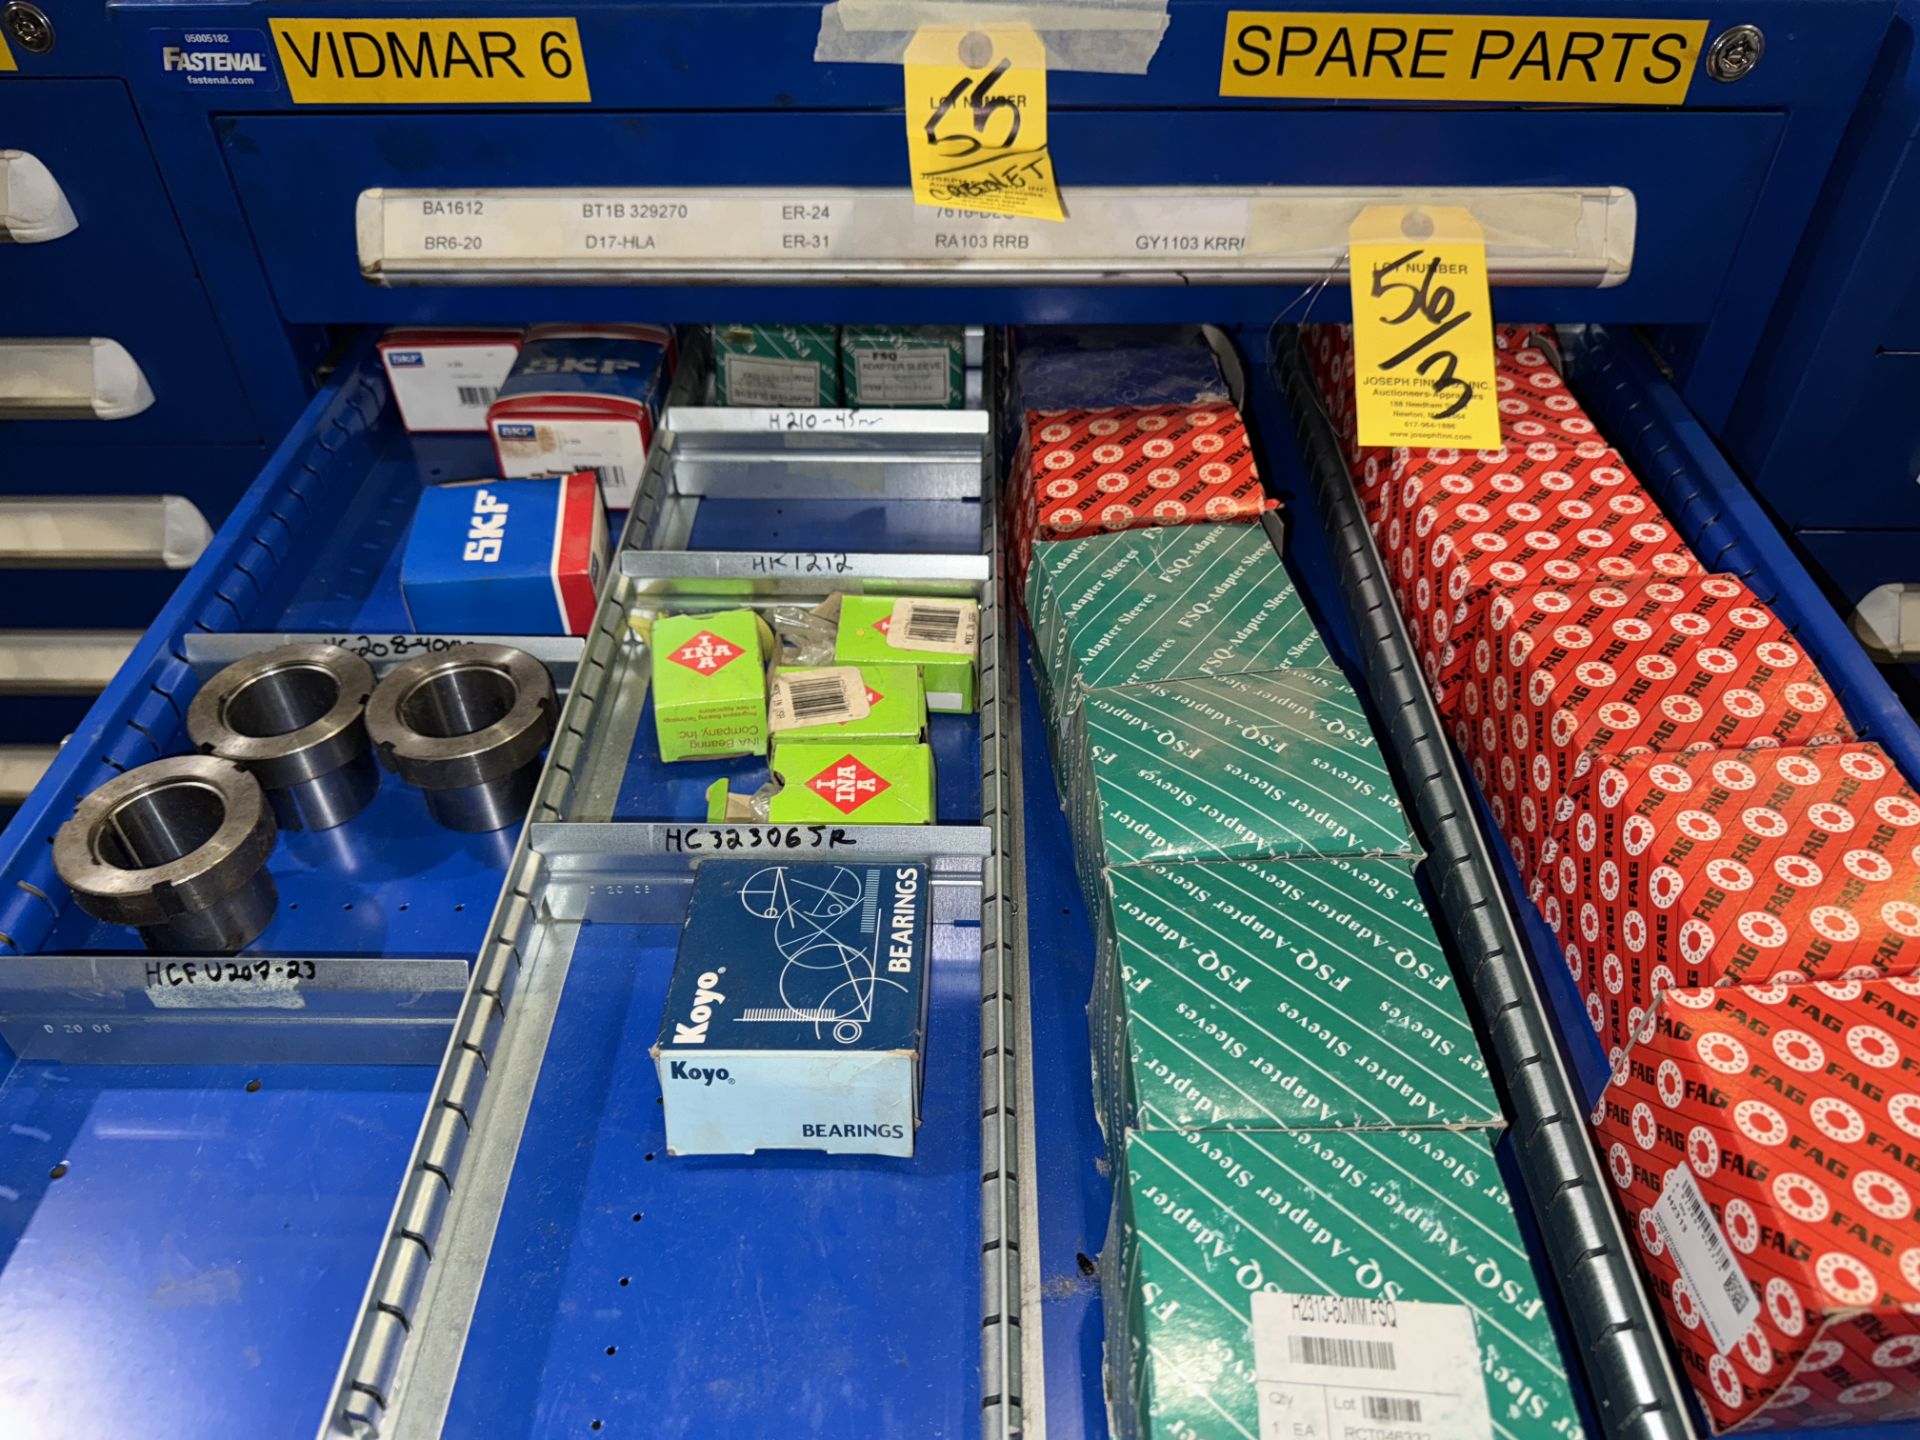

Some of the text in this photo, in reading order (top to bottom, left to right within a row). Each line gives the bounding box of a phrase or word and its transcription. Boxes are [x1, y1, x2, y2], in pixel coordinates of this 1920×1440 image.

[184, 34, 230, 44] 05005182
[162, 46, 267, 72] FASTENAL
[282, 30, 573, 80] VIDMAR 6
[1232, 24, 1688, 85] SPARE PARTS
[187, 74, 255, 85] fastenal.com
[423, 201, 484, 216] BA1612
[582, 204, 688, 219] BT1B 329270
[782, 206, 830, 220] ER-24
[424, 236, 483, 251] BR6-20
[585, 236, 656, 250] D17-HLA
[782, 235, 830, 249] ER-31
[935, 235, 1030, 250] RA103 RRB
[1136, 236, 1199, 251] GY1103
[522, 358, 640, 376] SKF
[862, 361, 942, 371] ADAPTER SLEEVE
[871, 351, 898, 361] FSQ
[1363, 377, 1410, 387] JOSEPH
[1405, 401, 1443, 409] Needham
[501, 426, 532, 437] SKF
[1511, 459, 1535, 478] FAG
[1476, 488, 1501, 509] FAG
[1527, 487, 1552, 506] FAG
[1578, 483, 1603, 502] FAG
[462, 489, 510, 563] SKF
[1494, 518, 1519, 537] FAG
[1545, 514, 1571, 534] FAG
[752, 554, 854, 573] HK1212
[1101, 548, 1140, 581] Sleeves
[1158, 524, 1226, 584] FSQ-Adapter
[1117, 591, 1158, 626] Sleeves
[1177, 564, 1247, 629] FSQ-Adapter
[1517, 610, 1547, 635] FAG
[1575, 606, 1606, 629] FAG
[1198, 609, 1270, 676] FSQ-Adapter
[1598, 640, 1628, 666] FAG
[1717, 627, 1747, 652] FAG
[1135, 637, 1177, 672] Sleeves
[1538, 646, 1568, 674] FAG
[1620, 678, 1654, 706] FAG
[1682, 671, 1714, 699] FAG
[663, 716, 697, 724] Technology
[698, 714, 722, 722] Bearing
[701, 724, 759, 738] Company,
[1090, 699, 1204, 760] FSQ-Adapter
[1172, 694, 1288, 755] FSQ-Adapter
[1253, 688, 1376, 749] FSQ-Adapter
[1709, 715, 1742, 748] FAG
[688, 737, 761, 750] INA Bearing
[1646, 720, 1679, 752] FAG
[1137, 767, 1198, 808] Sleeves
[1223, 762, 1287, 802] Sleeves
[1310, 756, 1377, 797] Sleeves
[1662, 837, 1695, 868] FAG
[1729, 834, 1763, 864] FAG
[1797, 829, 1829, 861] FAG
[1865, 825, 1898, 854] FAG
[1629, 861, 1639, 907] FAG
[1691, 887, 1727, 922] FAG
[1762, 883, 1798, 917] FAG
[888, 867, 918, 974] BEARINGS
[1118, 901, 1253, 993] FSQ-Adapter
[1212, 899, 1353, 993] FSQ-Adapter
[1307, 898, 1453, 992] FSQ-Adapter
[1656, 914, 1668, 962] FAG
[1797, 938, 1833, 978] FAG
[1786, 995, 1842, 1032] FAG
[1861, 990, 1919, 1029] FAG
[1175, 1001, 1248, 1059] Sleeves
[1276, 1000, 1353, 1058] Sleeves
[1378, 1000, 1456, 1057] Sleeves
[1655, 1014, 1694, 1042] FAG
[670, 1060, 730, 1086] Koyo
[1629, 1061, 1655, 1086] FAG
[1824, 1060, 1884, 1102] FAG
[1684, 1080, 1730, 1109] FAG
[801, 1123, 905, 1140] BEARINGS
[1719, 1147, 1769, 1182] FAG
[1787, 1137, 1850, 1181] FAG
[1369, 1181, 1544, 1322] FSQ-Adapter
[1759, 1224, 1813, 1264] FAG
[1268, 1391, 1295, 1410] Qty
[1333, 1398, 1357, 1412] Lot
[1272, 1422, 1316, 1437] 1 EA
